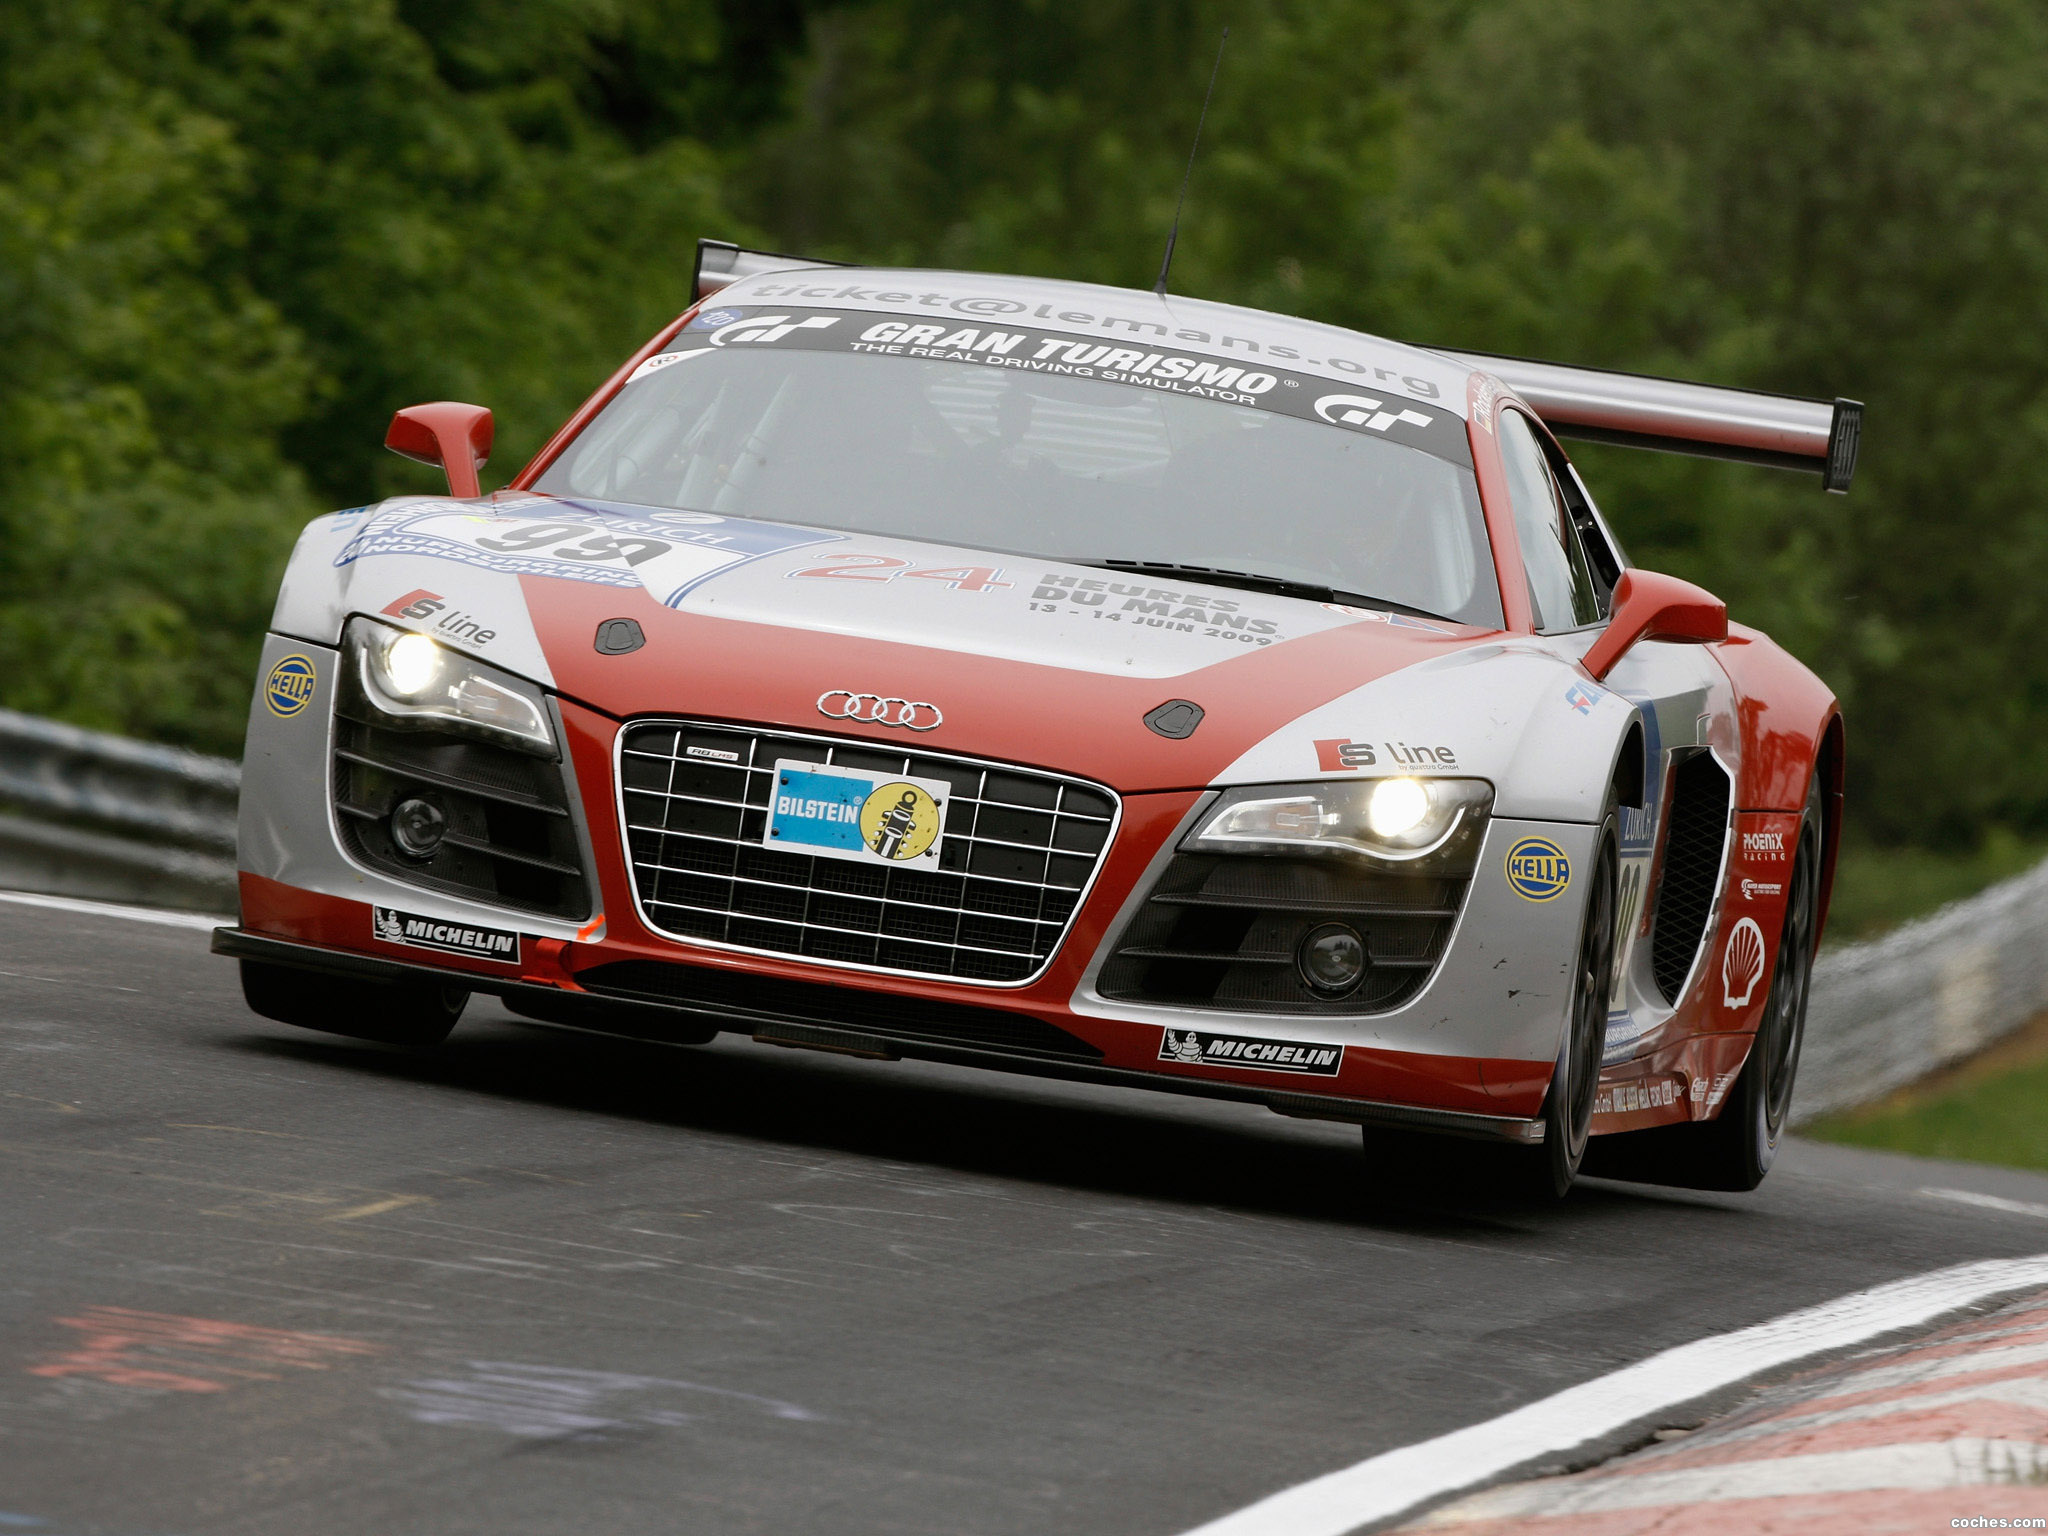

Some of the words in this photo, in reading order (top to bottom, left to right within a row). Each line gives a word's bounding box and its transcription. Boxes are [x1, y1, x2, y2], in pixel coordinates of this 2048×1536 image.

[752, 284, 1441, 399] ticket@lemans.org
[860, 321, 1027, 356] GRAN
[1033, 338, 1278, 394] TURISMO
[850, 342, 904, 354] THE
[909, 347, 978, 362] REAL
[986, 355, 1094, 378] DRIVING
[1101, 371, 1256, 406] SIMULATOR
[547, 512, 735, 545] ZURICH
[783, 552, 1017, 594] 24
[400, 598, 446, 620] S
[1039, 573, 1240, 612] HEURES
[1028, 602, 1057, 613] 13
[1093, 610, 1122, 622] 14
[1132, 616, 1195, 633] JUIN
[1204, 627, 1273, 646] 2009
[1031, 586, 1109, 606] DU
[1121, 598, 1280, 635] MANS
[269, 672, 315, 702] HELLA
[1338, 743, 1377, 767] S
[777, 796, 860, 825] BILSTEIN
[1510, 854, 1570, 884] HELLA
[405, 919, 514, 953] MICHELIN
[1206, 1039, 1338, 1066] MICHELIN
